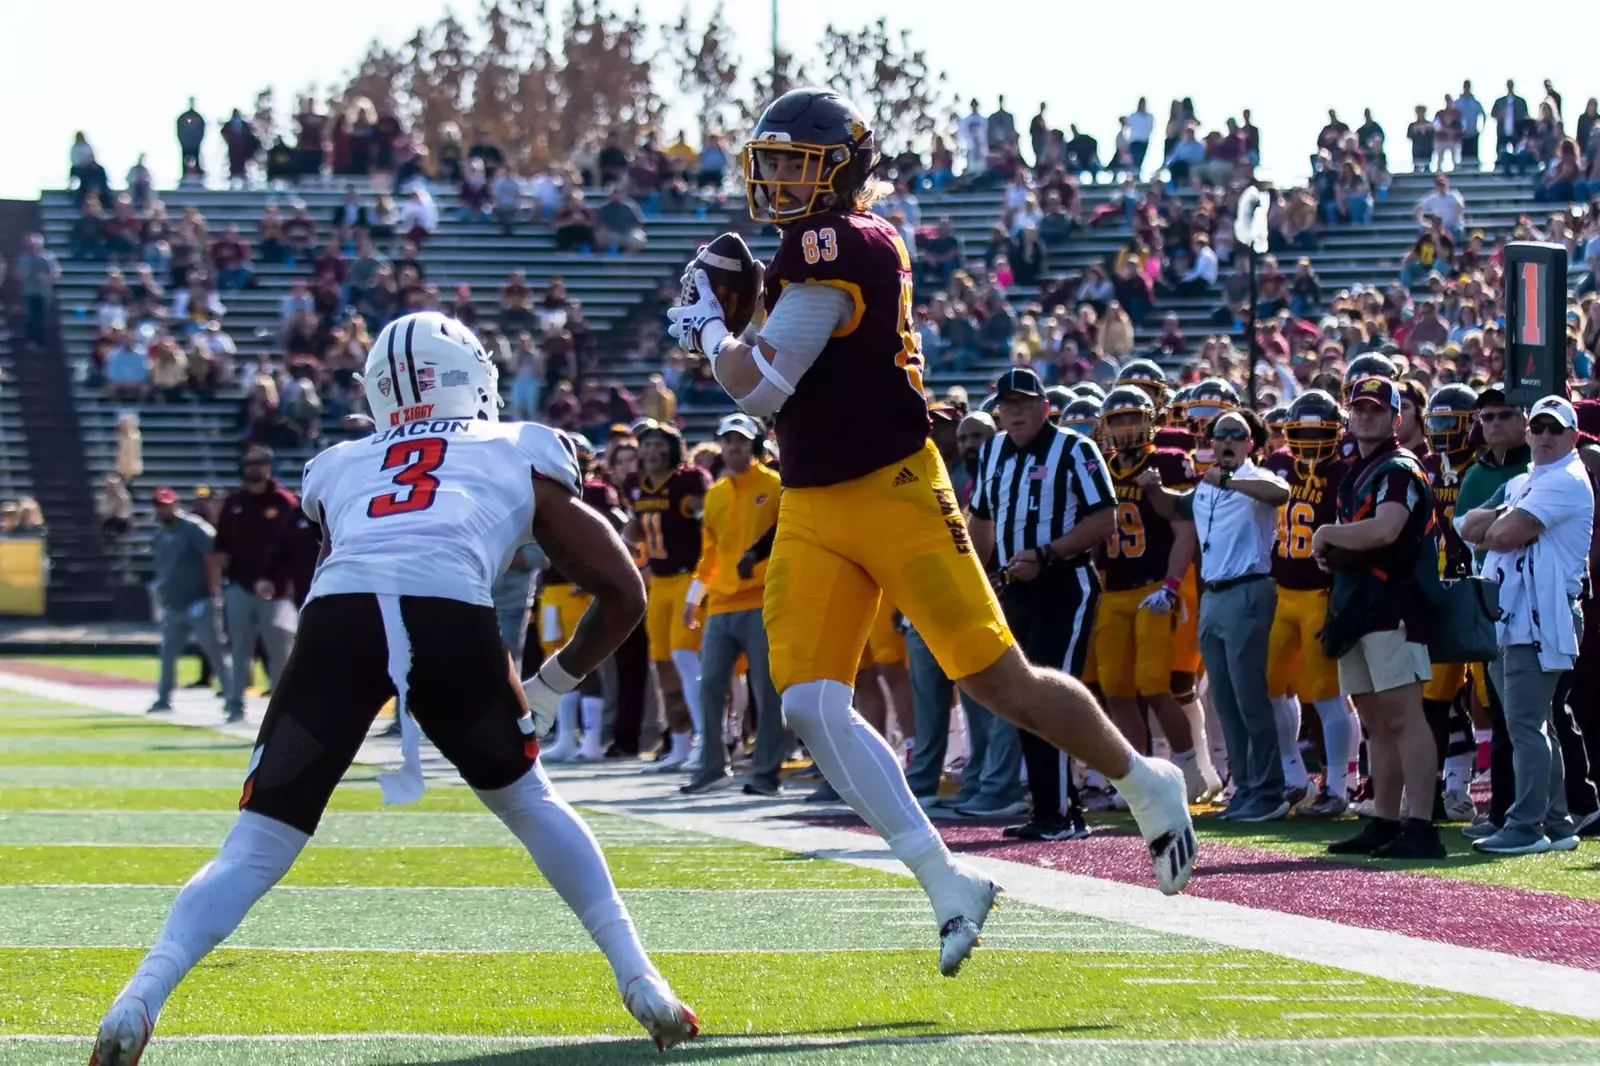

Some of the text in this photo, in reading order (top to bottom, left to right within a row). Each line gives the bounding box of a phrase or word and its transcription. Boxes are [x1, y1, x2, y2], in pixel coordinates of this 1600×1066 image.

[802, 228, 838, 264] 83
[1522, 262, 1540, 344] 1
[399, 362, 406, 372] 3
[403, 404, 435, 423] ZIGGY
[366, 437, 448, 519] 3
[1029, 496, 1039, 511] L
[642, 511, 668, 559] 11
